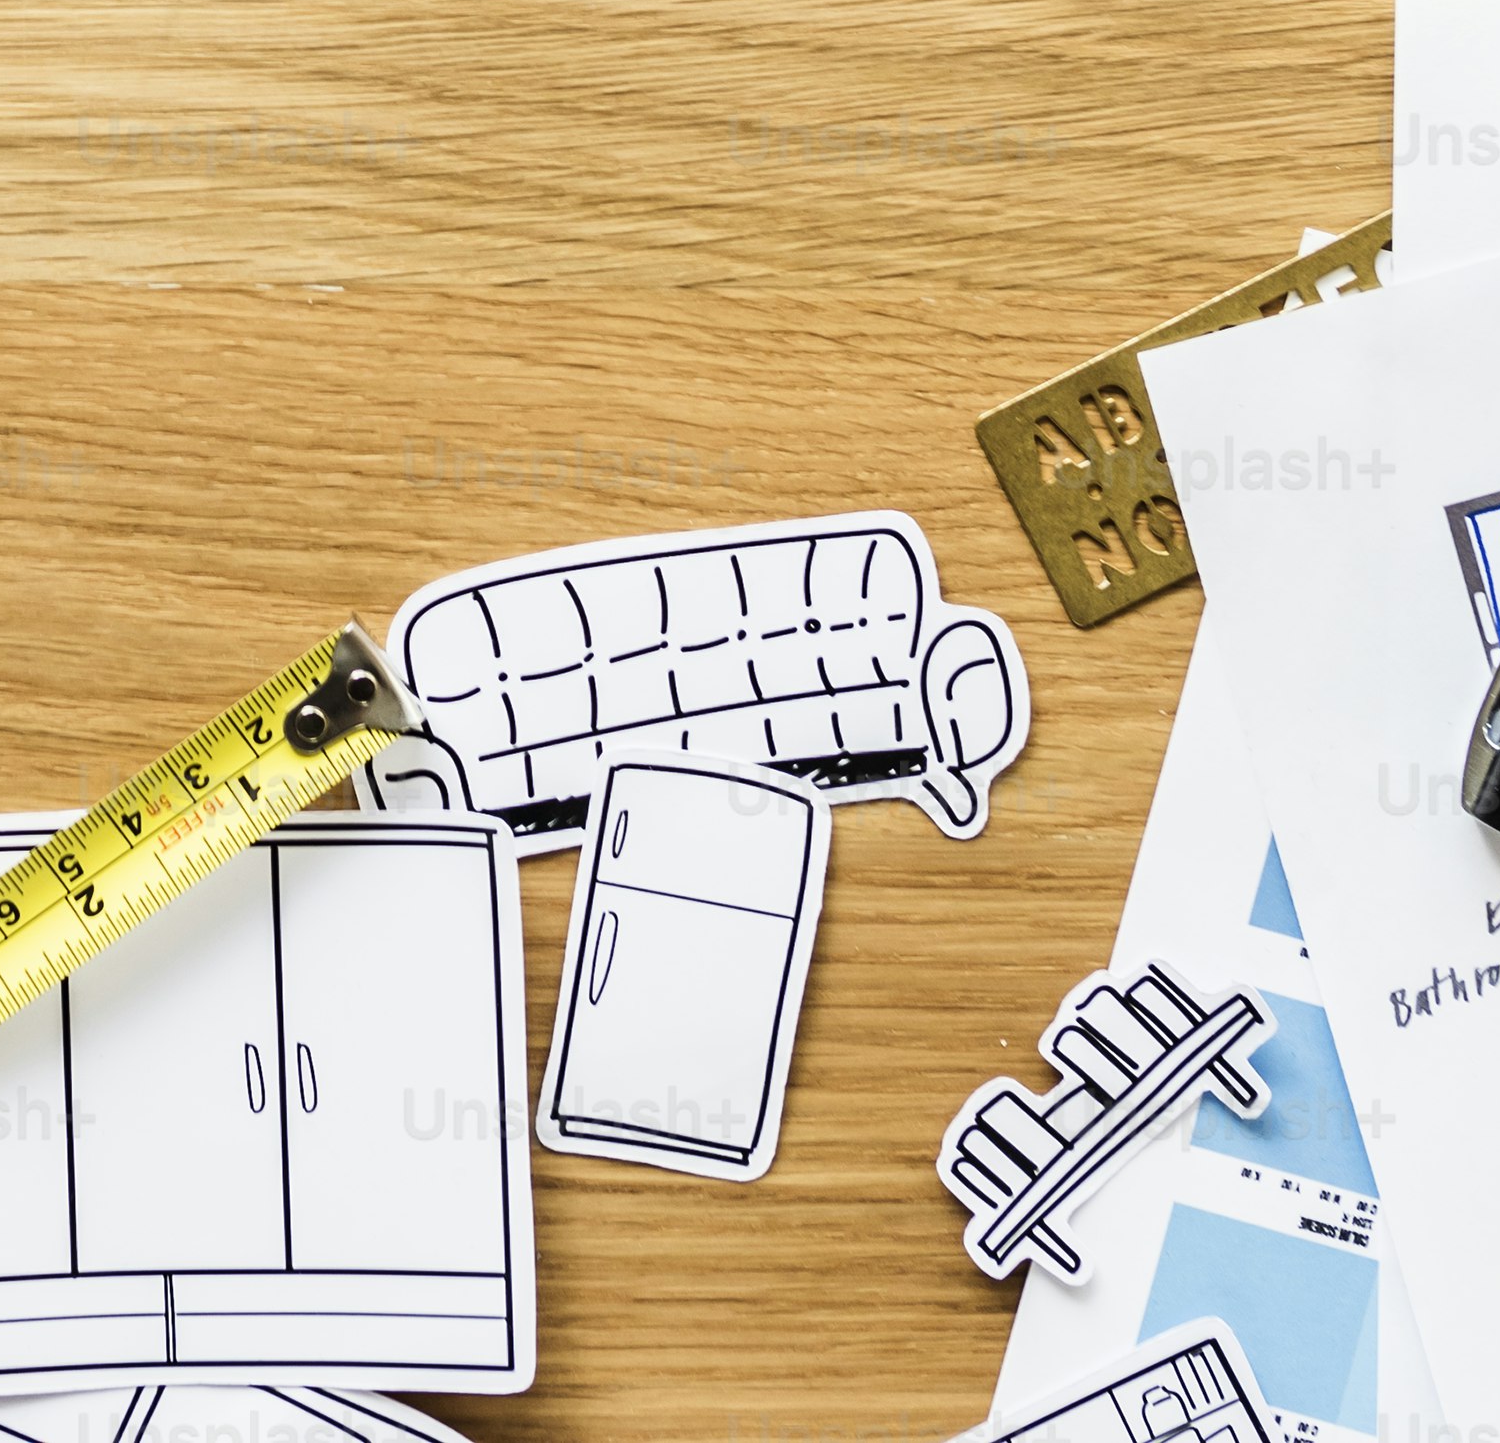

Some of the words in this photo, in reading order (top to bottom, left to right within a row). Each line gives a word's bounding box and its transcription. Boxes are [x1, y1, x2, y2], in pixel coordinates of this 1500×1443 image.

[244, 718, 273, 744] 2
[183, 763, 210, 790] 3
[120, 811, 143, 837] 4
[58, 853, 84, 882] 5
[74, 884, 104, 917] 2
